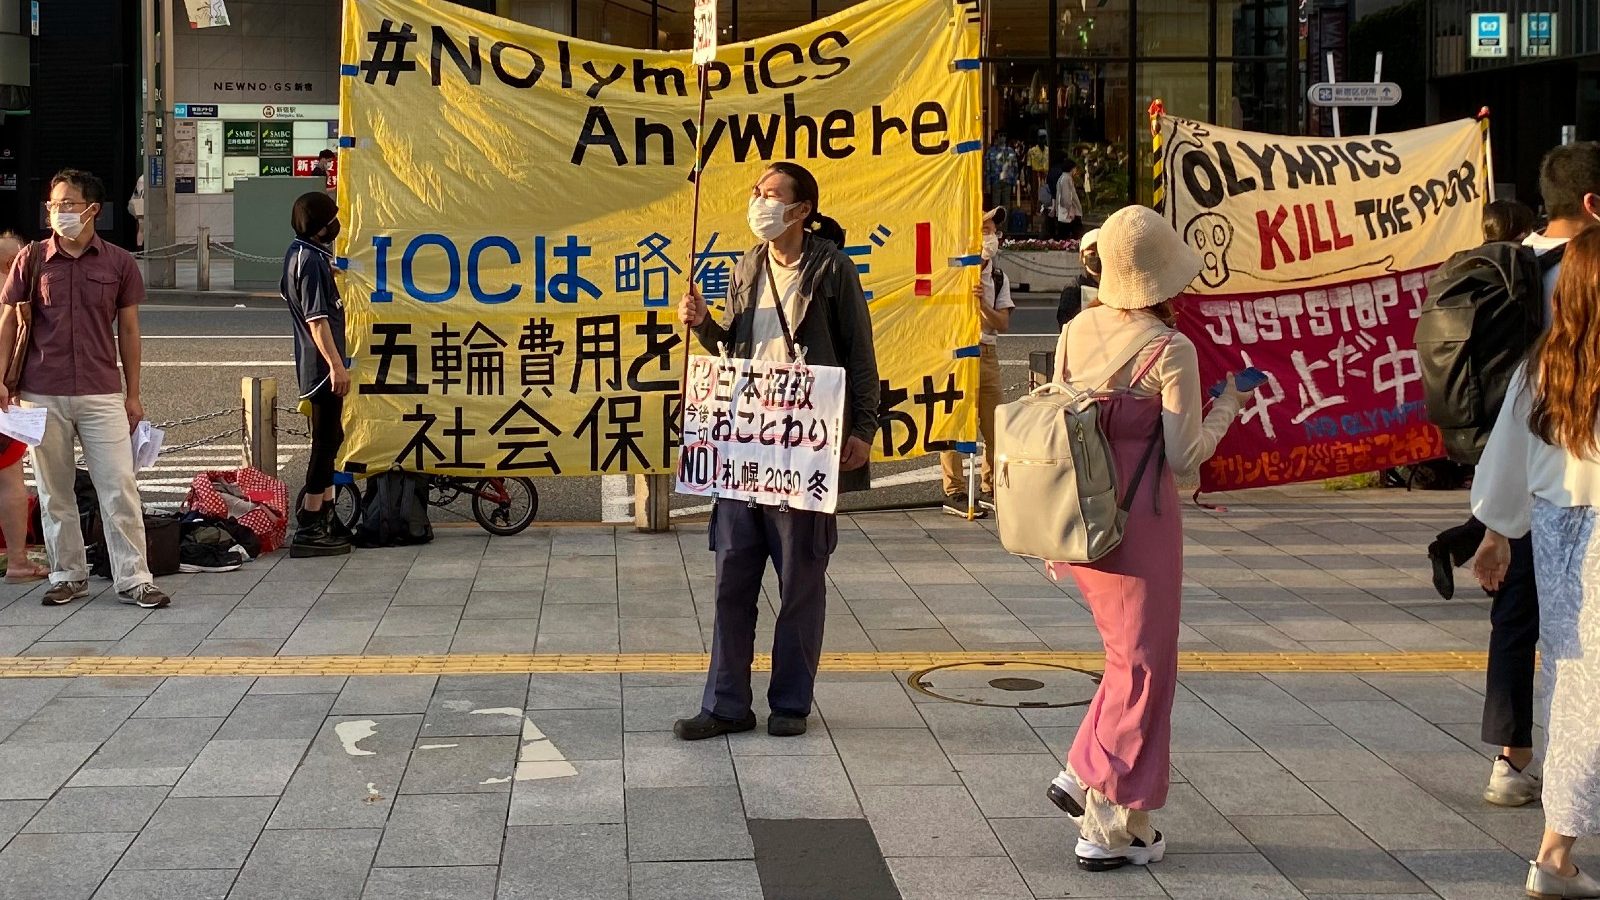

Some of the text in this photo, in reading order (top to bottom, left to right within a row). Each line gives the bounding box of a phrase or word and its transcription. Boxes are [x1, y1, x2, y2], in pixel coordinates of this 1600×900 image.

[235, 130, 256, 138] SMBC
[269, 130, 291, 138] SMBC
[570, 93, 950, 182] Anywhere
[270, 166, 291, 174] SMBC
[1182, 139, 1402, 208] OLYMPICS
[1256, 199, 1354, 271] KILL
[1355, 193, 1414, 241] THE
[1201, 293, 1304, 346] JUST
[1304, 276, 1399, 337] STOP
[712, 407, 828, 452] おことわり
[680, 445, 718, 489] NO!
[721, 458, 829, 501] 札幌 2030 冬
